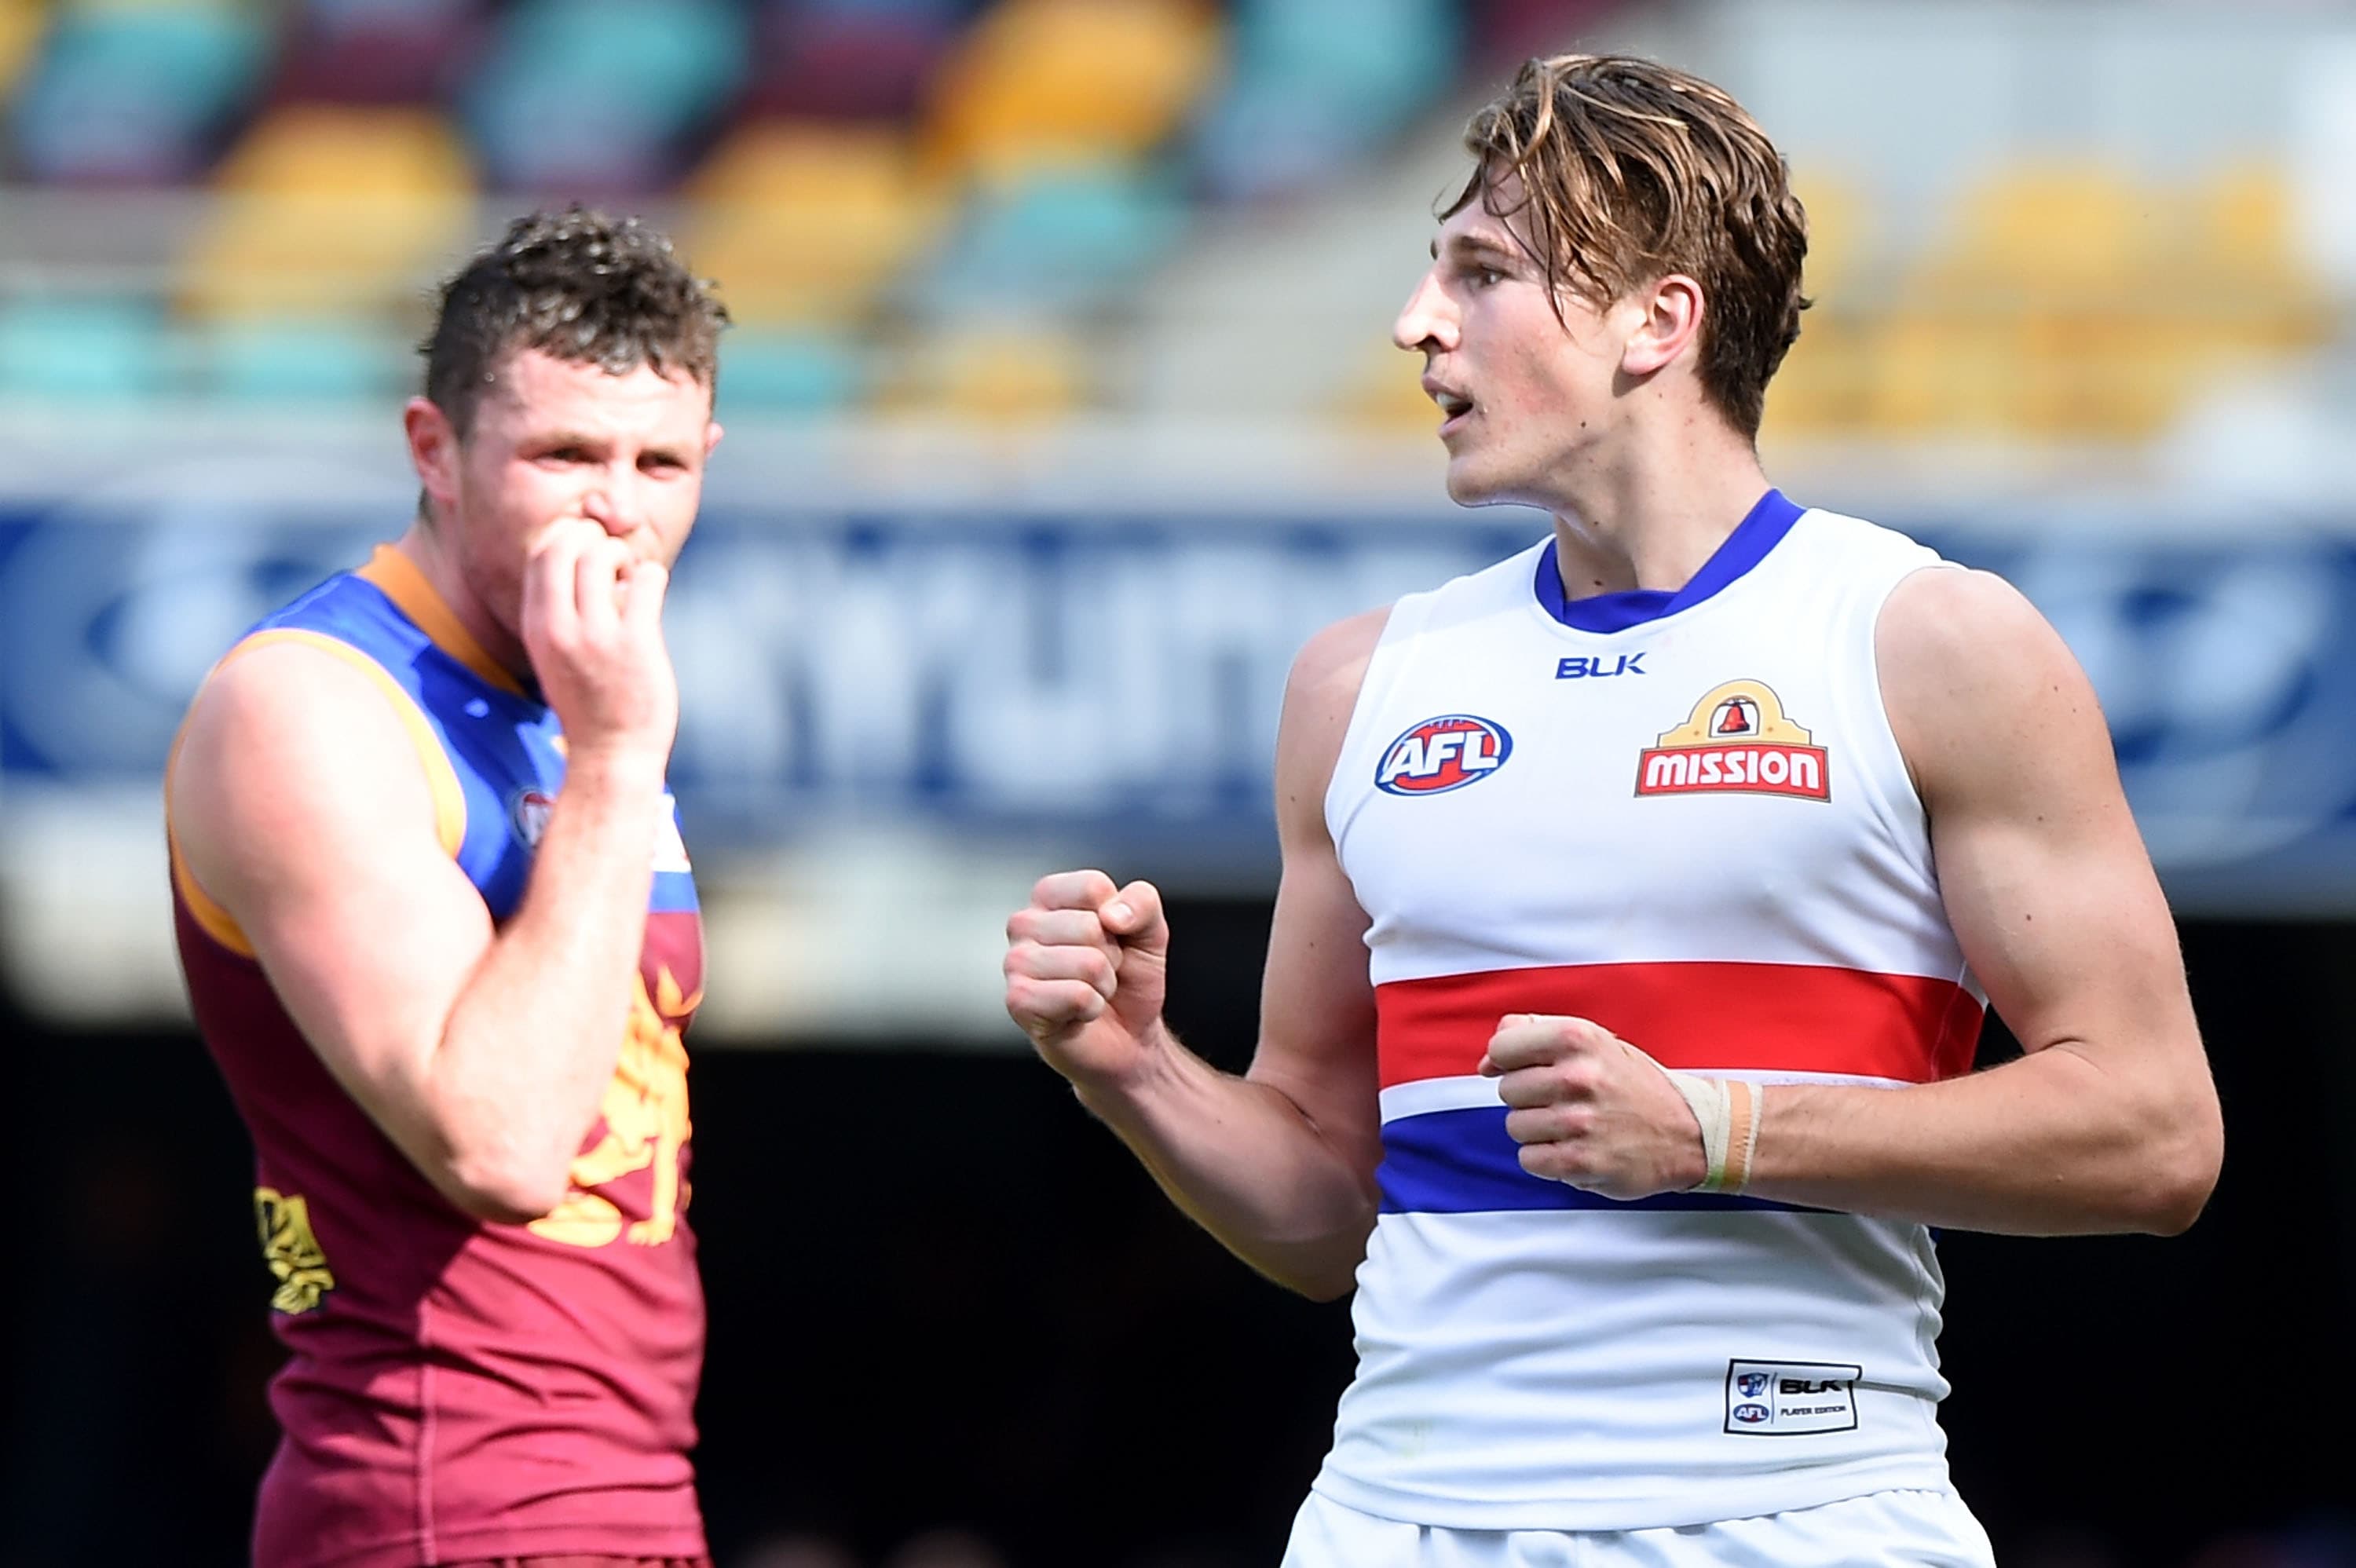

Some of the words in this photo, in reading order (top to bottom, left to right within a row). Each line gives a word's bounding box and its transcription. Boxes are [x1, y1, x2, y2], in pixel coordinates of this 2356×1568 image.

[1555, 652, 1647, 680] BLK
[1382, 732, 1501, 783] AFL
[1645, 751, 1819, 790] MISSION
[1780, 1379, 1842, 1394] BLK
[1736, 1407, 1766, 1419] AFL
[1780, 1407, 1813, 1416] PLAYER
[1815, 1405, 1846, 1415] EDITION
